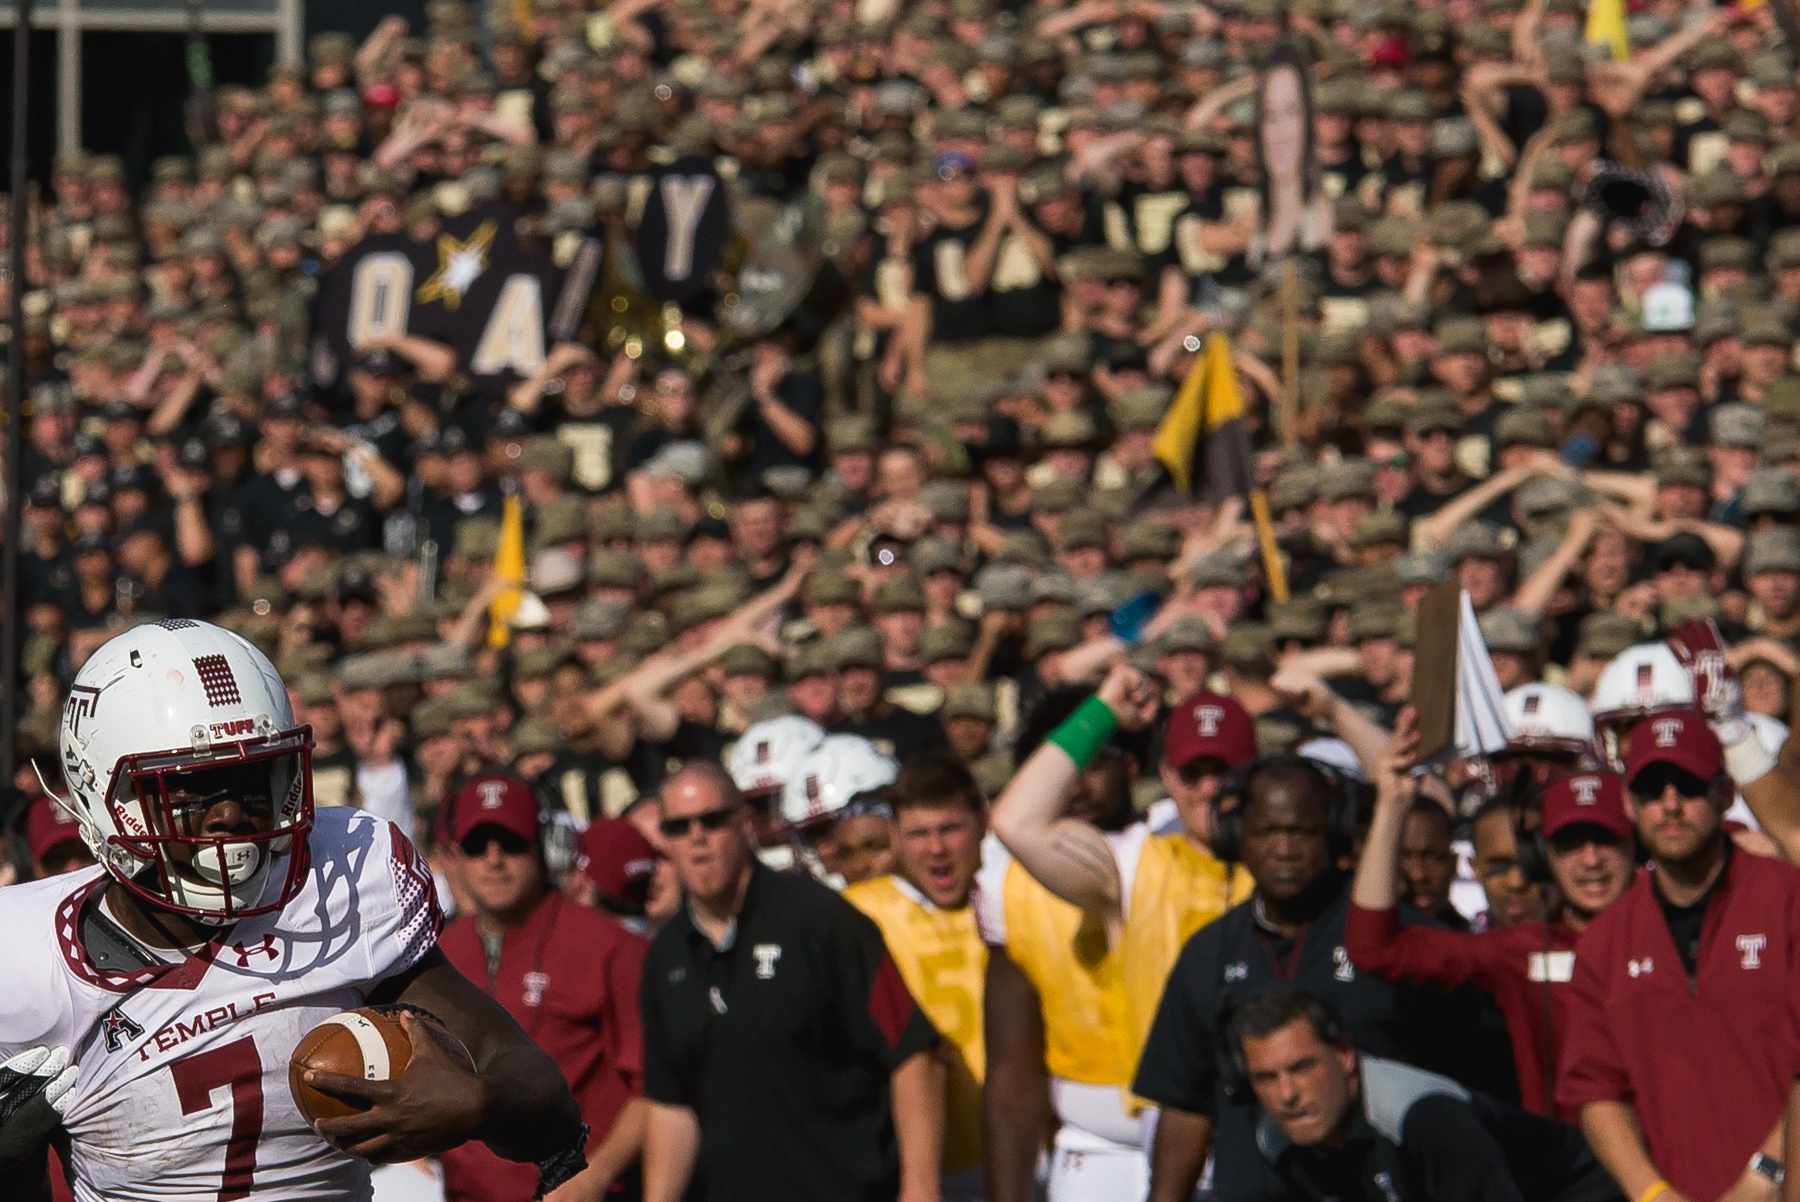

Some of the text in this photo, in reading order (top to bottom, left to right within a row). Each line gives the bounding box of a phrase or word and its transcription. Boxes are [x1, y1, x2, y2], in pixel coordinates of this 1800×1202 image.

[659, 173, 716, 282] Y
[470, 273, 548, 377] A
[210, 719, 255, 739] TUFF
[1193, 704, 1225, 737] T
[1652, 718, 1684, 747] T
[476, 780, 508, 809] T
[1569, 776, 1602, 806] T
[753, 944, 782, 979] T
[1735, 933, 1767, 970] T
[522, 971, 550, 1007] T
[138, 992, 277, 1062] TEMPLE
